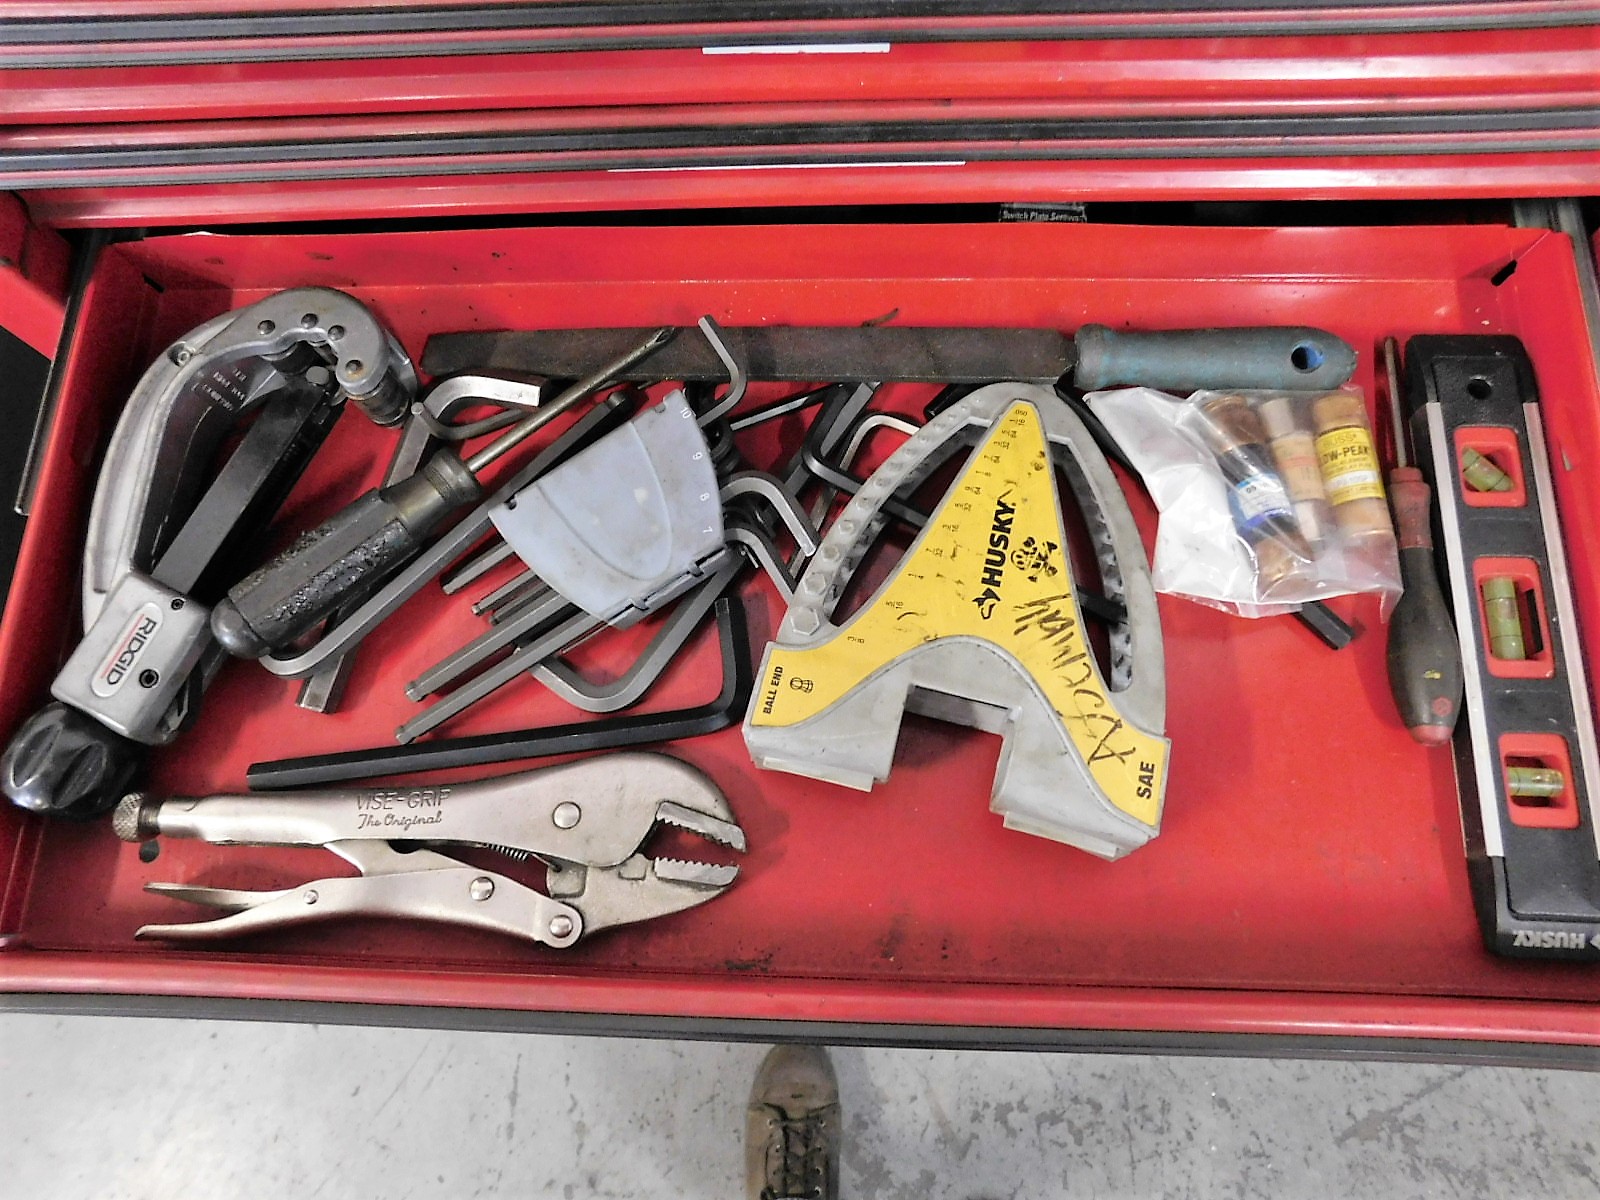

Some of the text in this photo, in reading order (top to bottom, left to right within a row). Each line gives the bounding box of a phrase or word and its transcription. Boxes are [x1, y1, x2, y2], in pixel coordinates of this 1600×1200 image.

[680, 407, 692, 419] 10
[692, 452, 703, 460] 9
[700, 492, 710, 501] 8
[981, 499, 1017, 587] HUSKY
[106, 616, 157, 685] RIDGID
[763, 666, 783, 714] BALL END
[1136, 760, 1155, 799] SAE
[357, 788, 451, 810] VISE-GRIP
[358, 810, 442, 830] The Original
[1513, 930, 1585, 949] HUSKY
